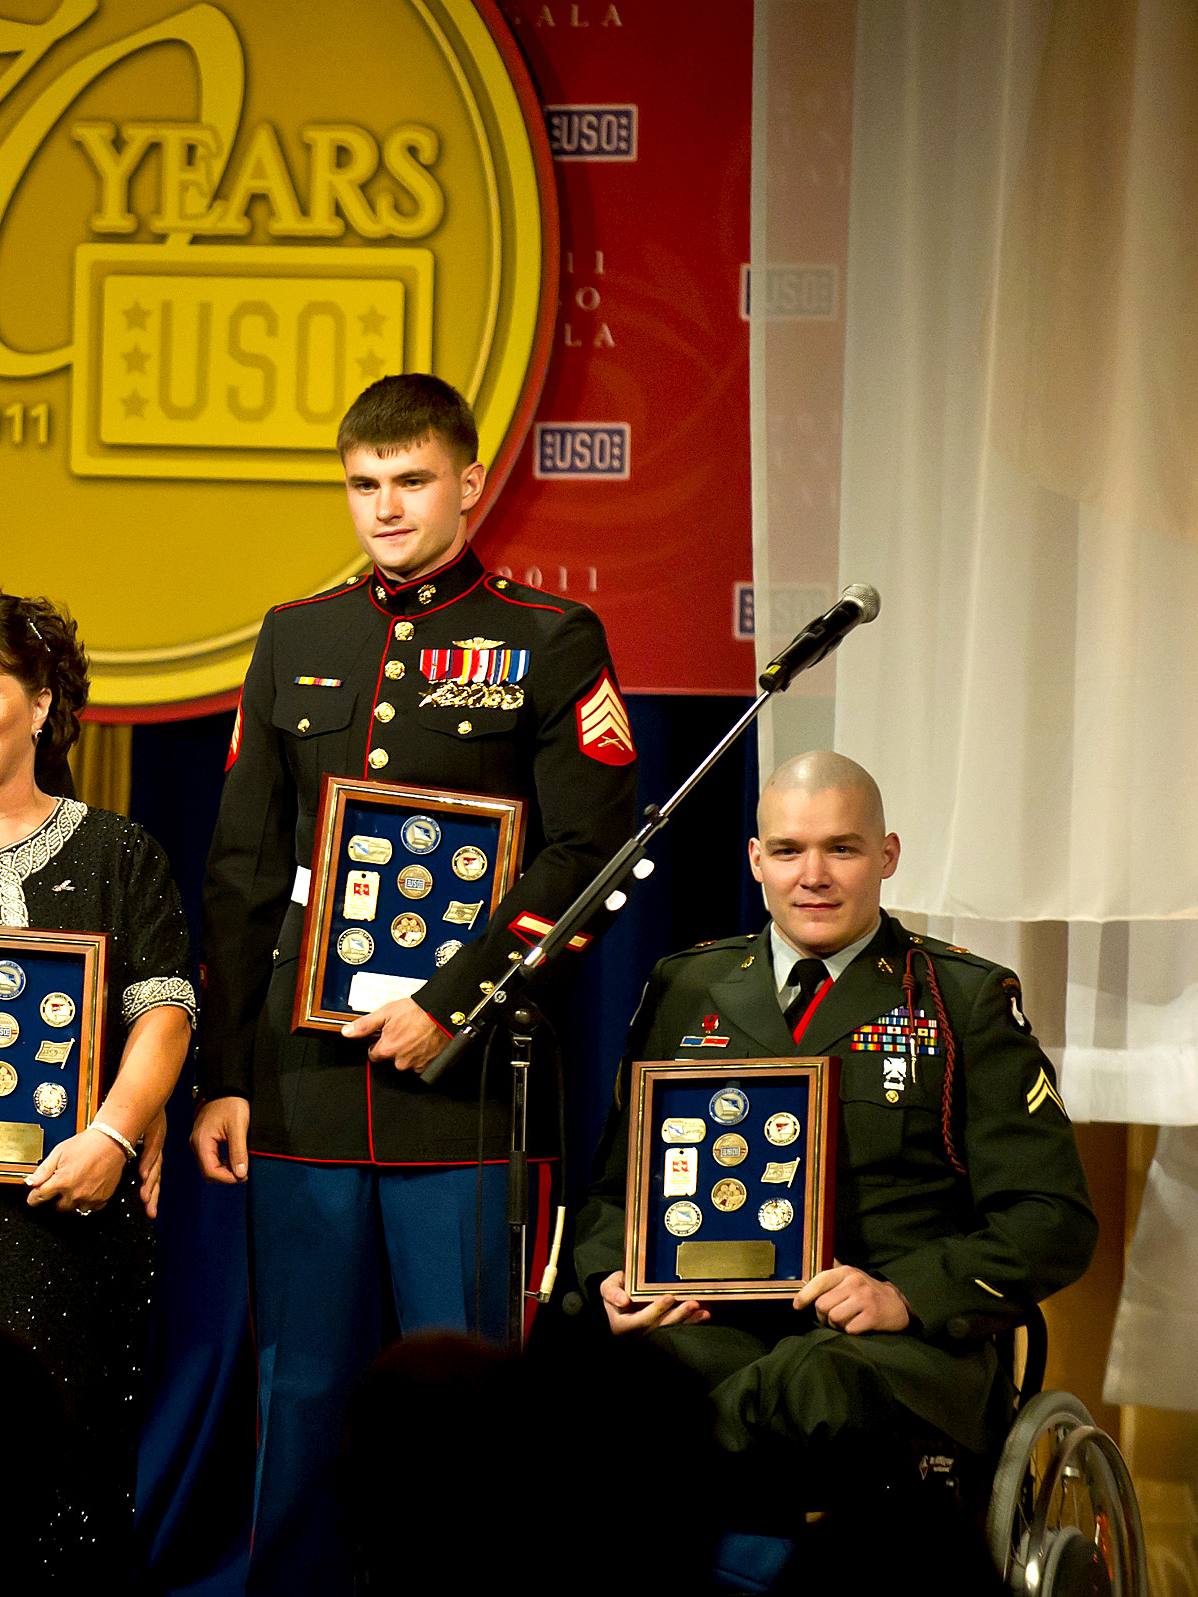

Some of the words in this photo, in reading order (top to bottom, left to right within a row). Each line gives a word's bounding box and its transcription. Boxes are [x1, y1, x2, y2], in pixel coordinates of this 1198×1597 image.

[515, 4, 623, 27] ALA
[562, 114, 618, 151] USO
[71, 121, 446, 239] YEARS
[159, 300, 347, 425] USO
[554, 431, 612, 470] USO
